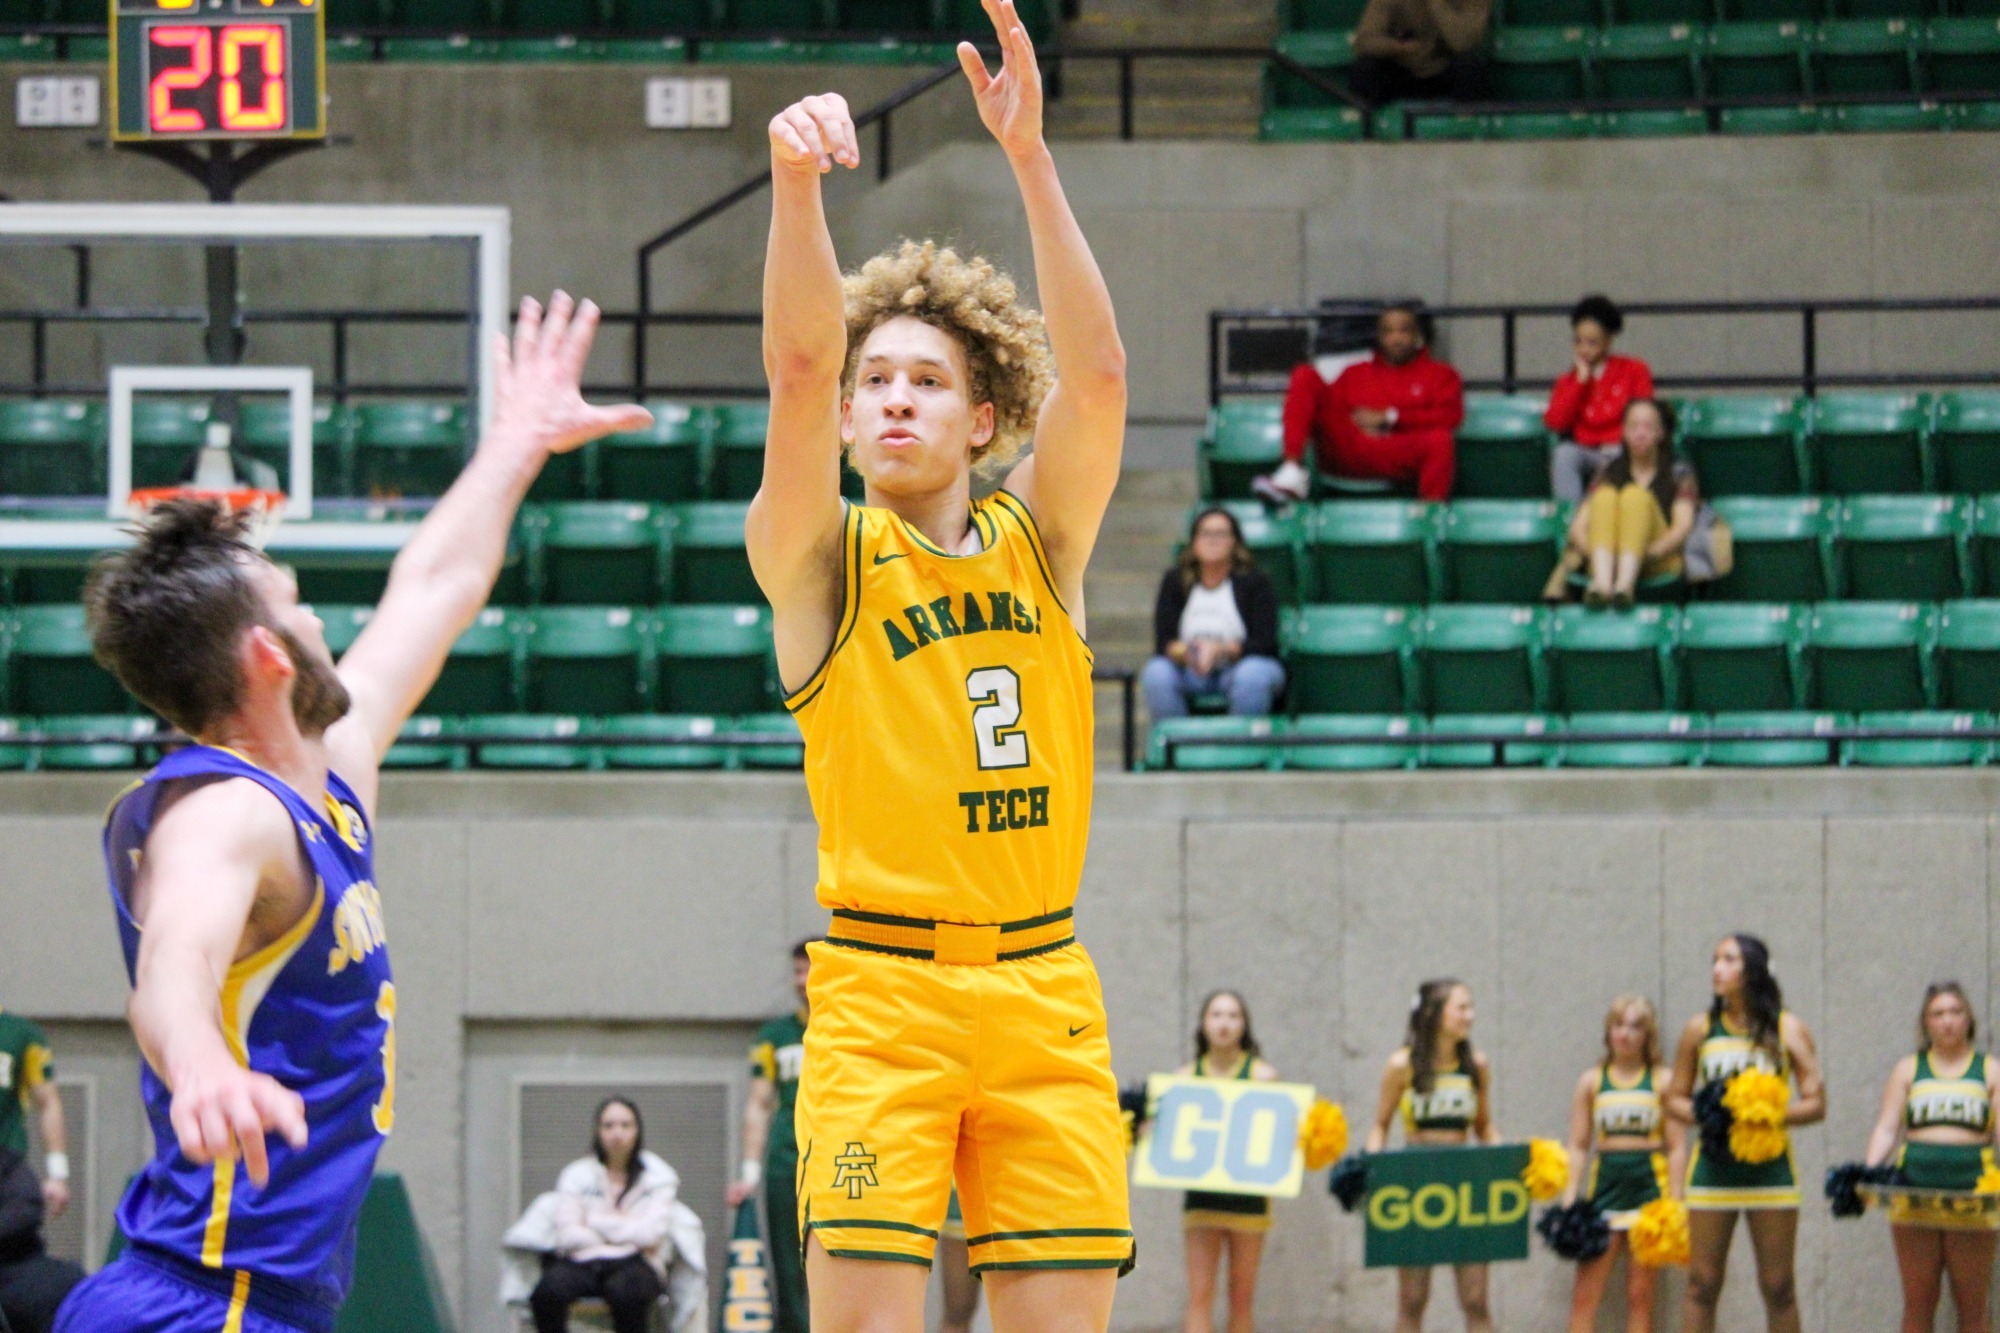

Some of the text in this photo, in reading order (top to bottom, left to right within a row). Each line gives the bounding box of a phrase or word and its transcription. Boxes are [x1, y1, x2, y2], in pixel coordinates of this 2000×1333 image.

[151, 25, 284, 131] 20
[965, 665, 1030, 771] 2
[958, 786, 1049, 833] TECH
[1149, 1085, 1300, 1185] GO
[1911, 1096, 1984, 1125] TECH
[1368, 1178, 1529, 1231] GOLD
